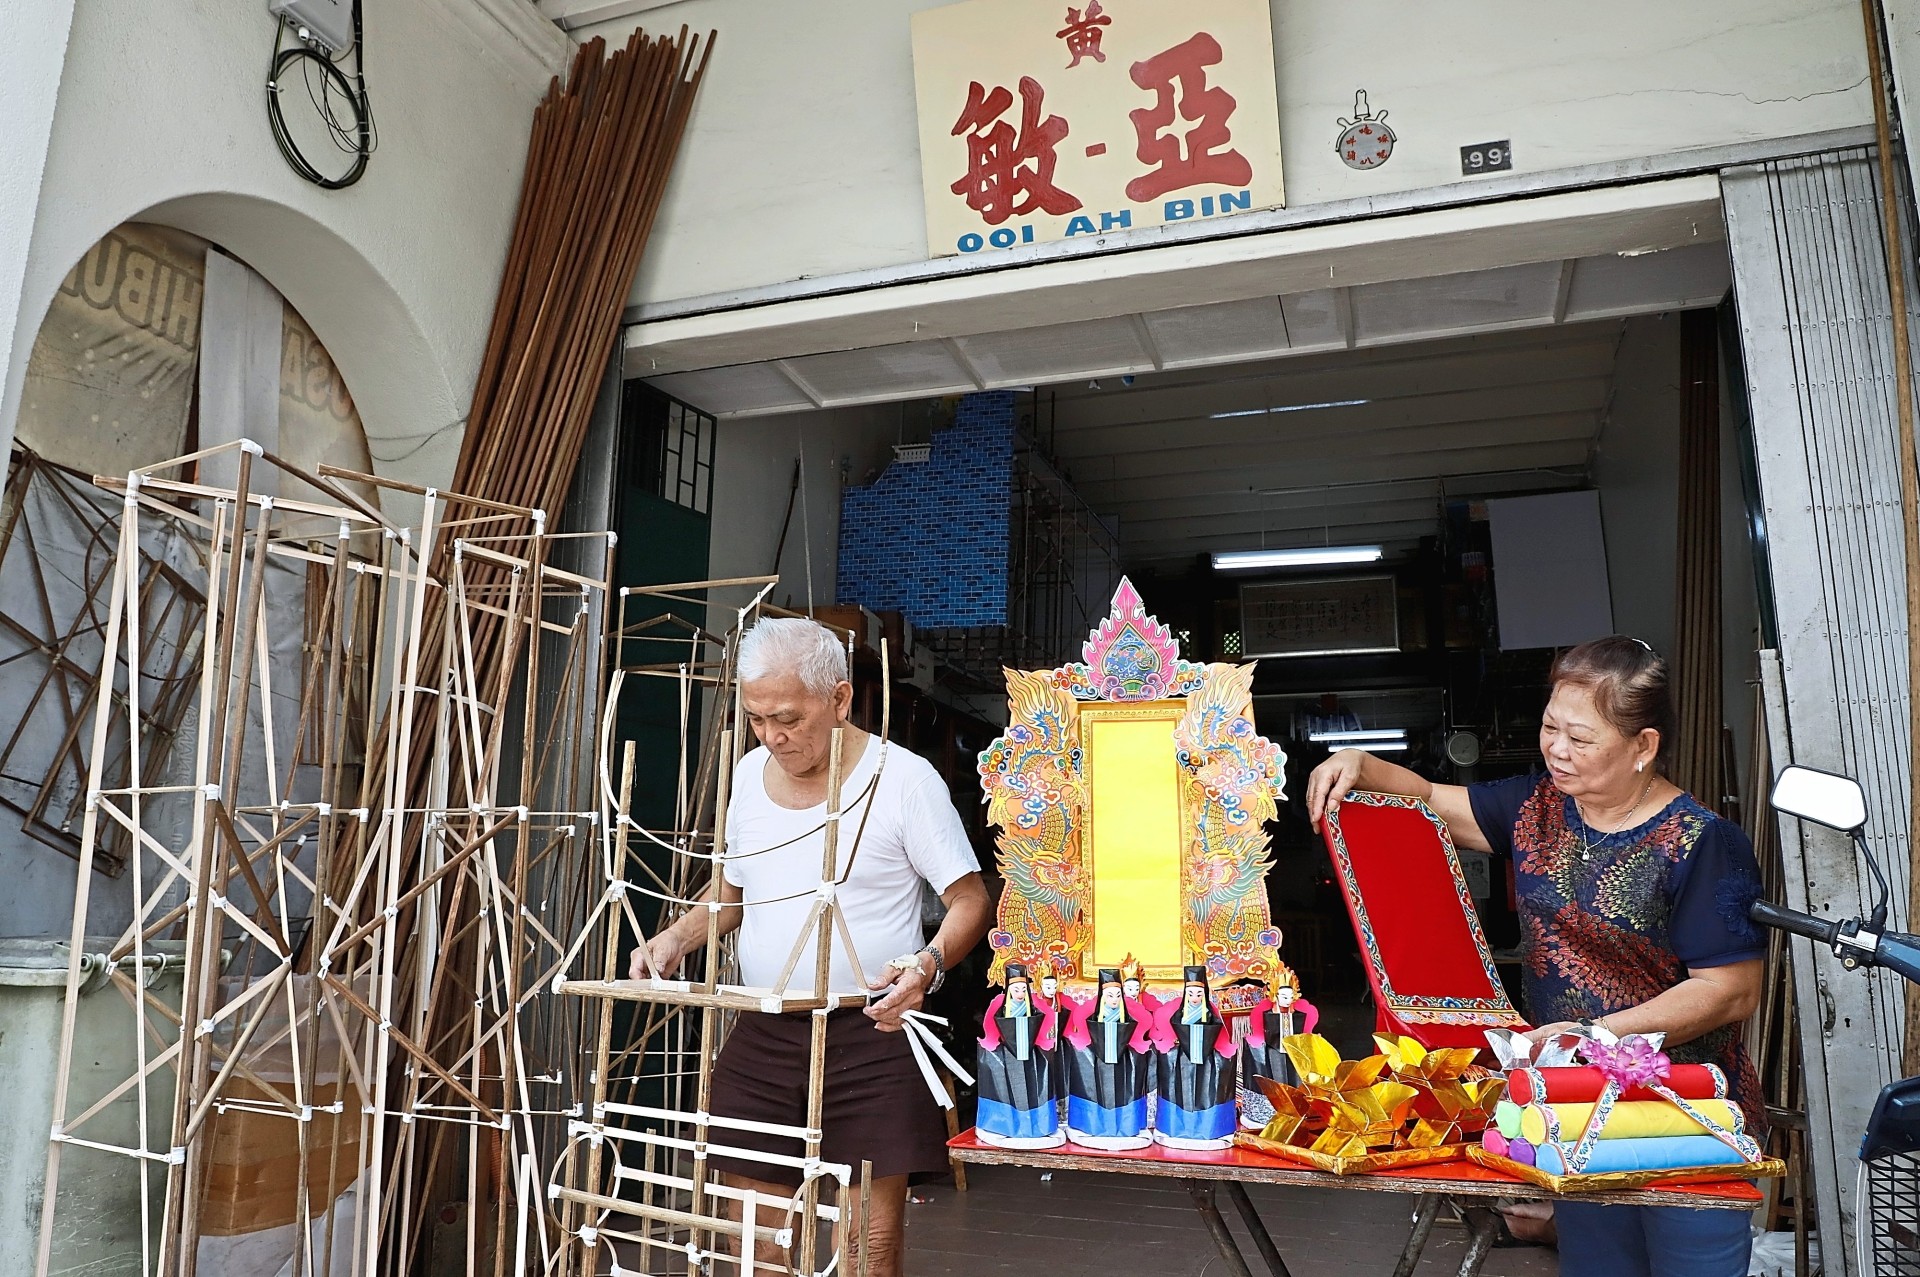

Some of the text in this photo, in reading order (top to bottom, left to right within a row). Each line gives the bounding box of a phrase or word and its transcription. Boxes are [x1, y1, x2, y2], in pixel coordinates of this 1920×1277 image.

[1469, 148, 1504, 169] 99
[957, 190, 1252, 253] OOI AH BIN
